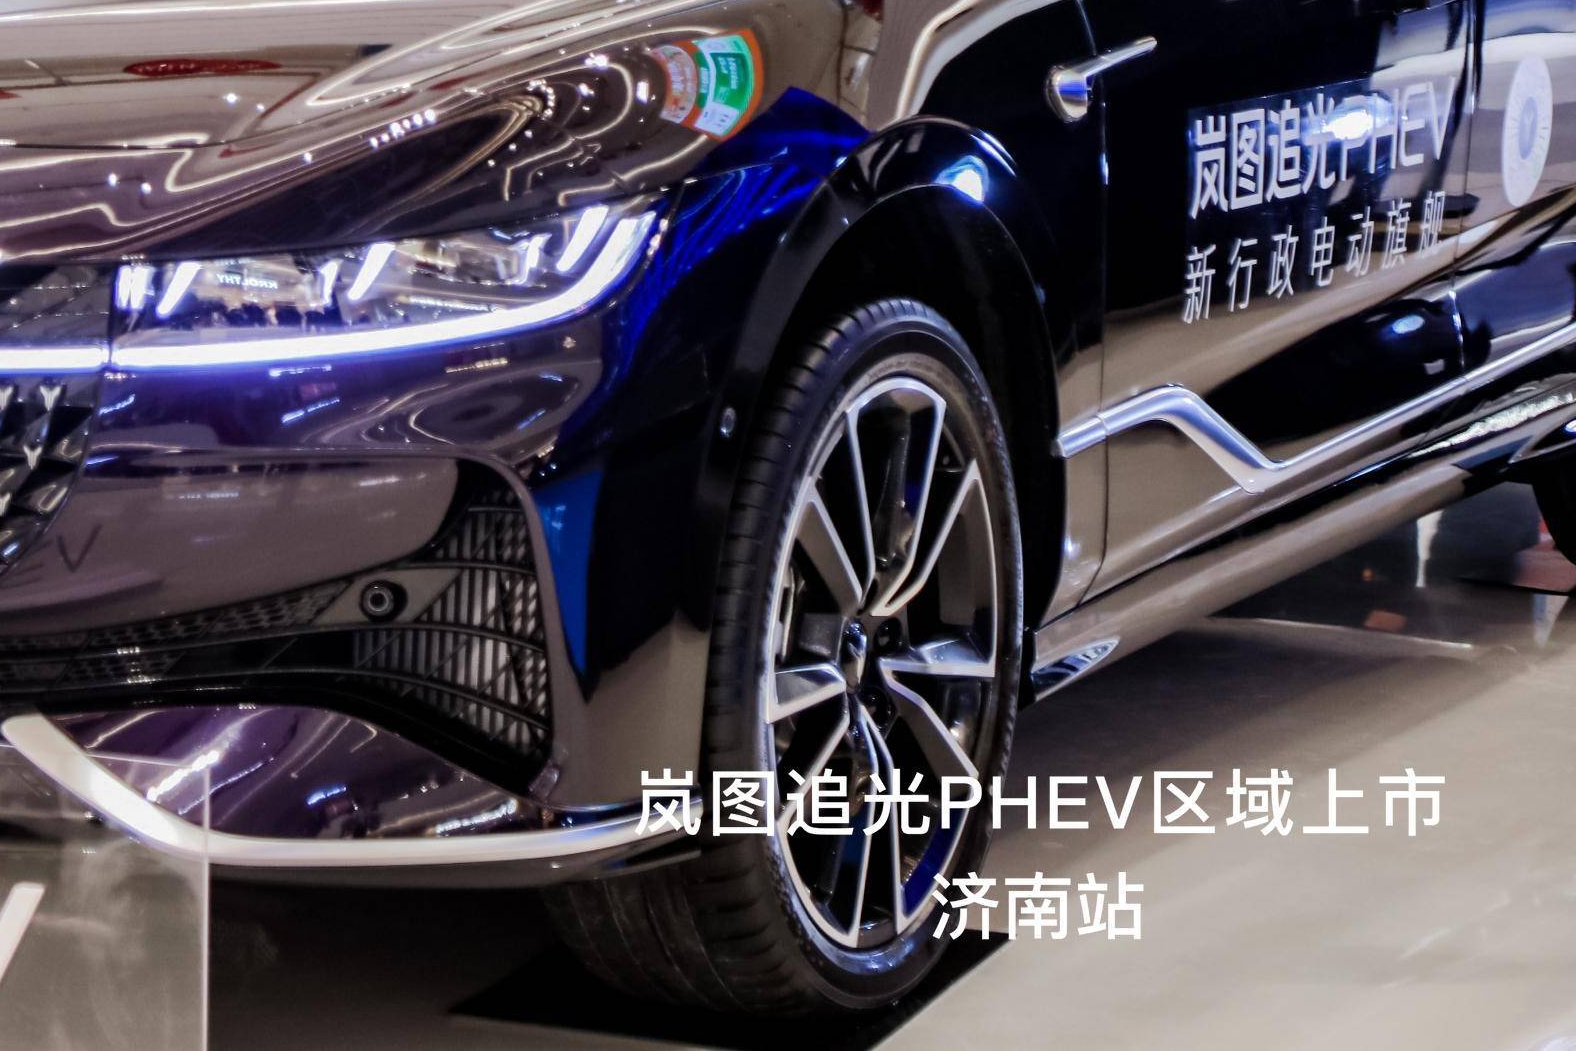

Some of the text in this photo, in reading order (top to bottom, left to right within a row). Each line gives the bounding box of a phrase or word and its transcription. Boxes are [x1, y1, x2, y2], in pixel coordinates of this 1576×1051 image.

[1189, 76, 1456, 220] 岚图追光PHEV
[1181, 190, 1447, 325] 新行政电动旗舰
